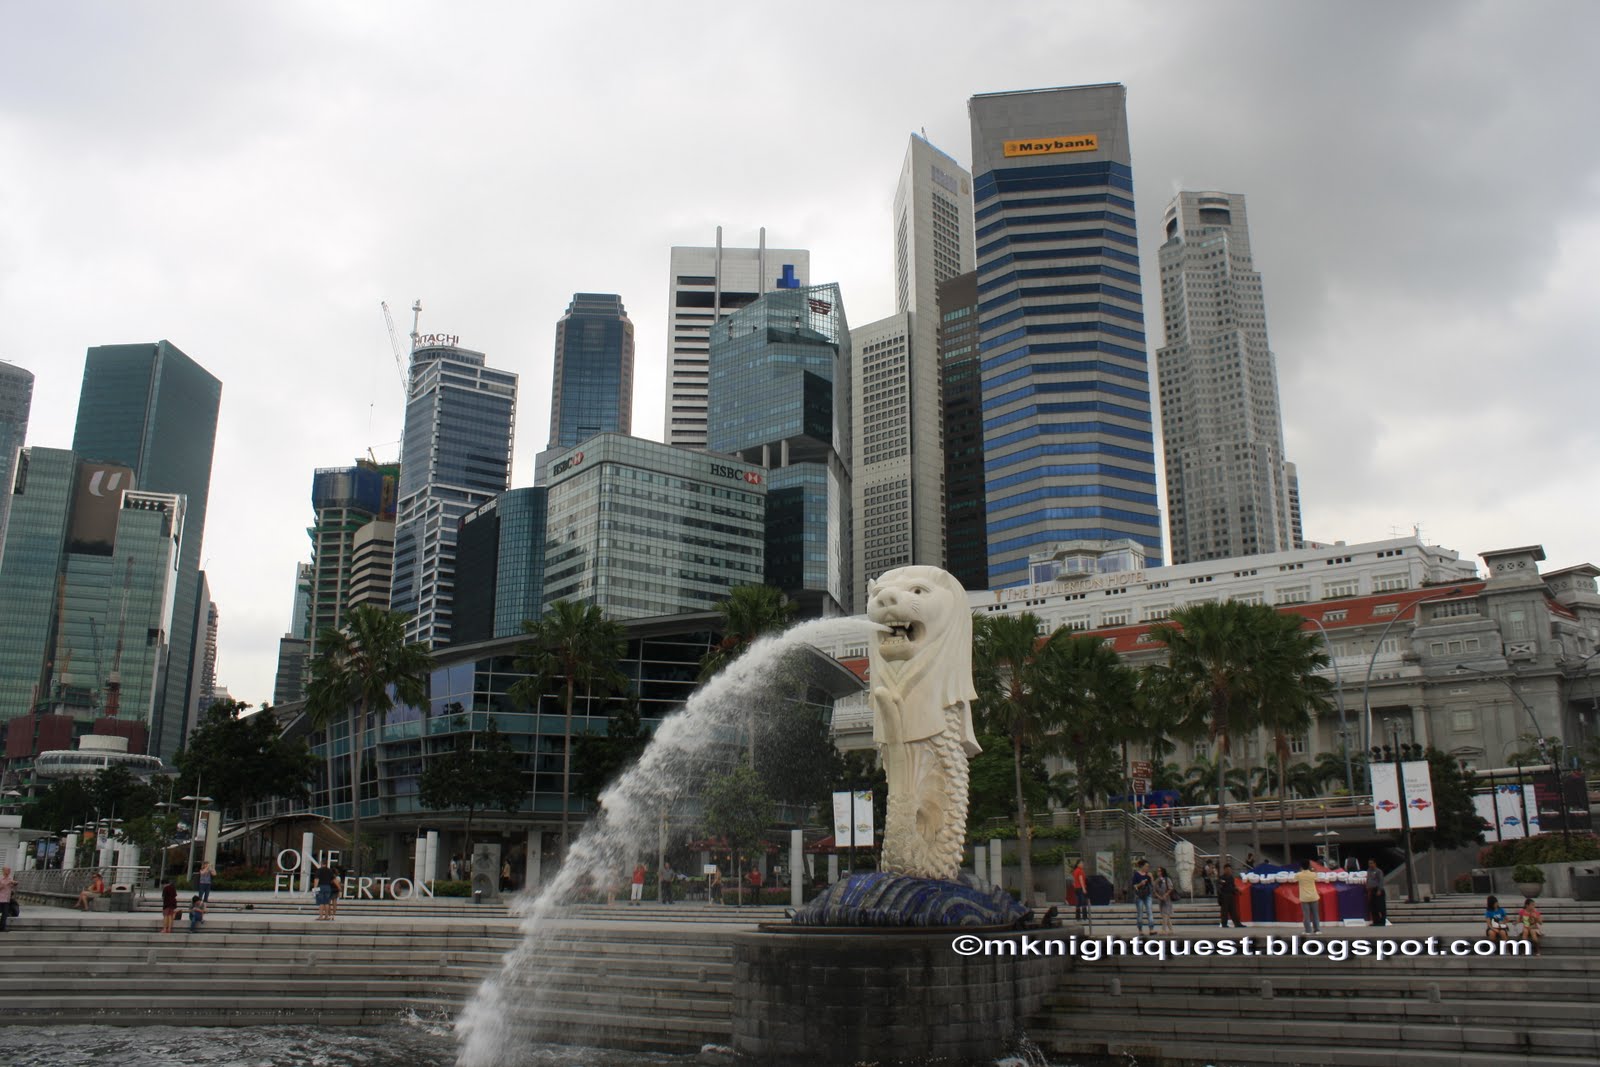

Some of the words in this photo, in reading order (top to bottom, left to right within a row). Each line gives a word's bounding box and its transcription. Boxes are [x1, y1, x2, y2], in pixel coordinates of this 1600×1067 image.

[1019, 139, 1095, 151] Maybank
[415, 333, 460, 346] HITACHI
[710, 463, 743, 481] HSBC
[1007, 588, 1029, 601] THE
[1032, 578, 1104, 597] FULLERTON
[1107, 571, 1149, 587] HOTEL
